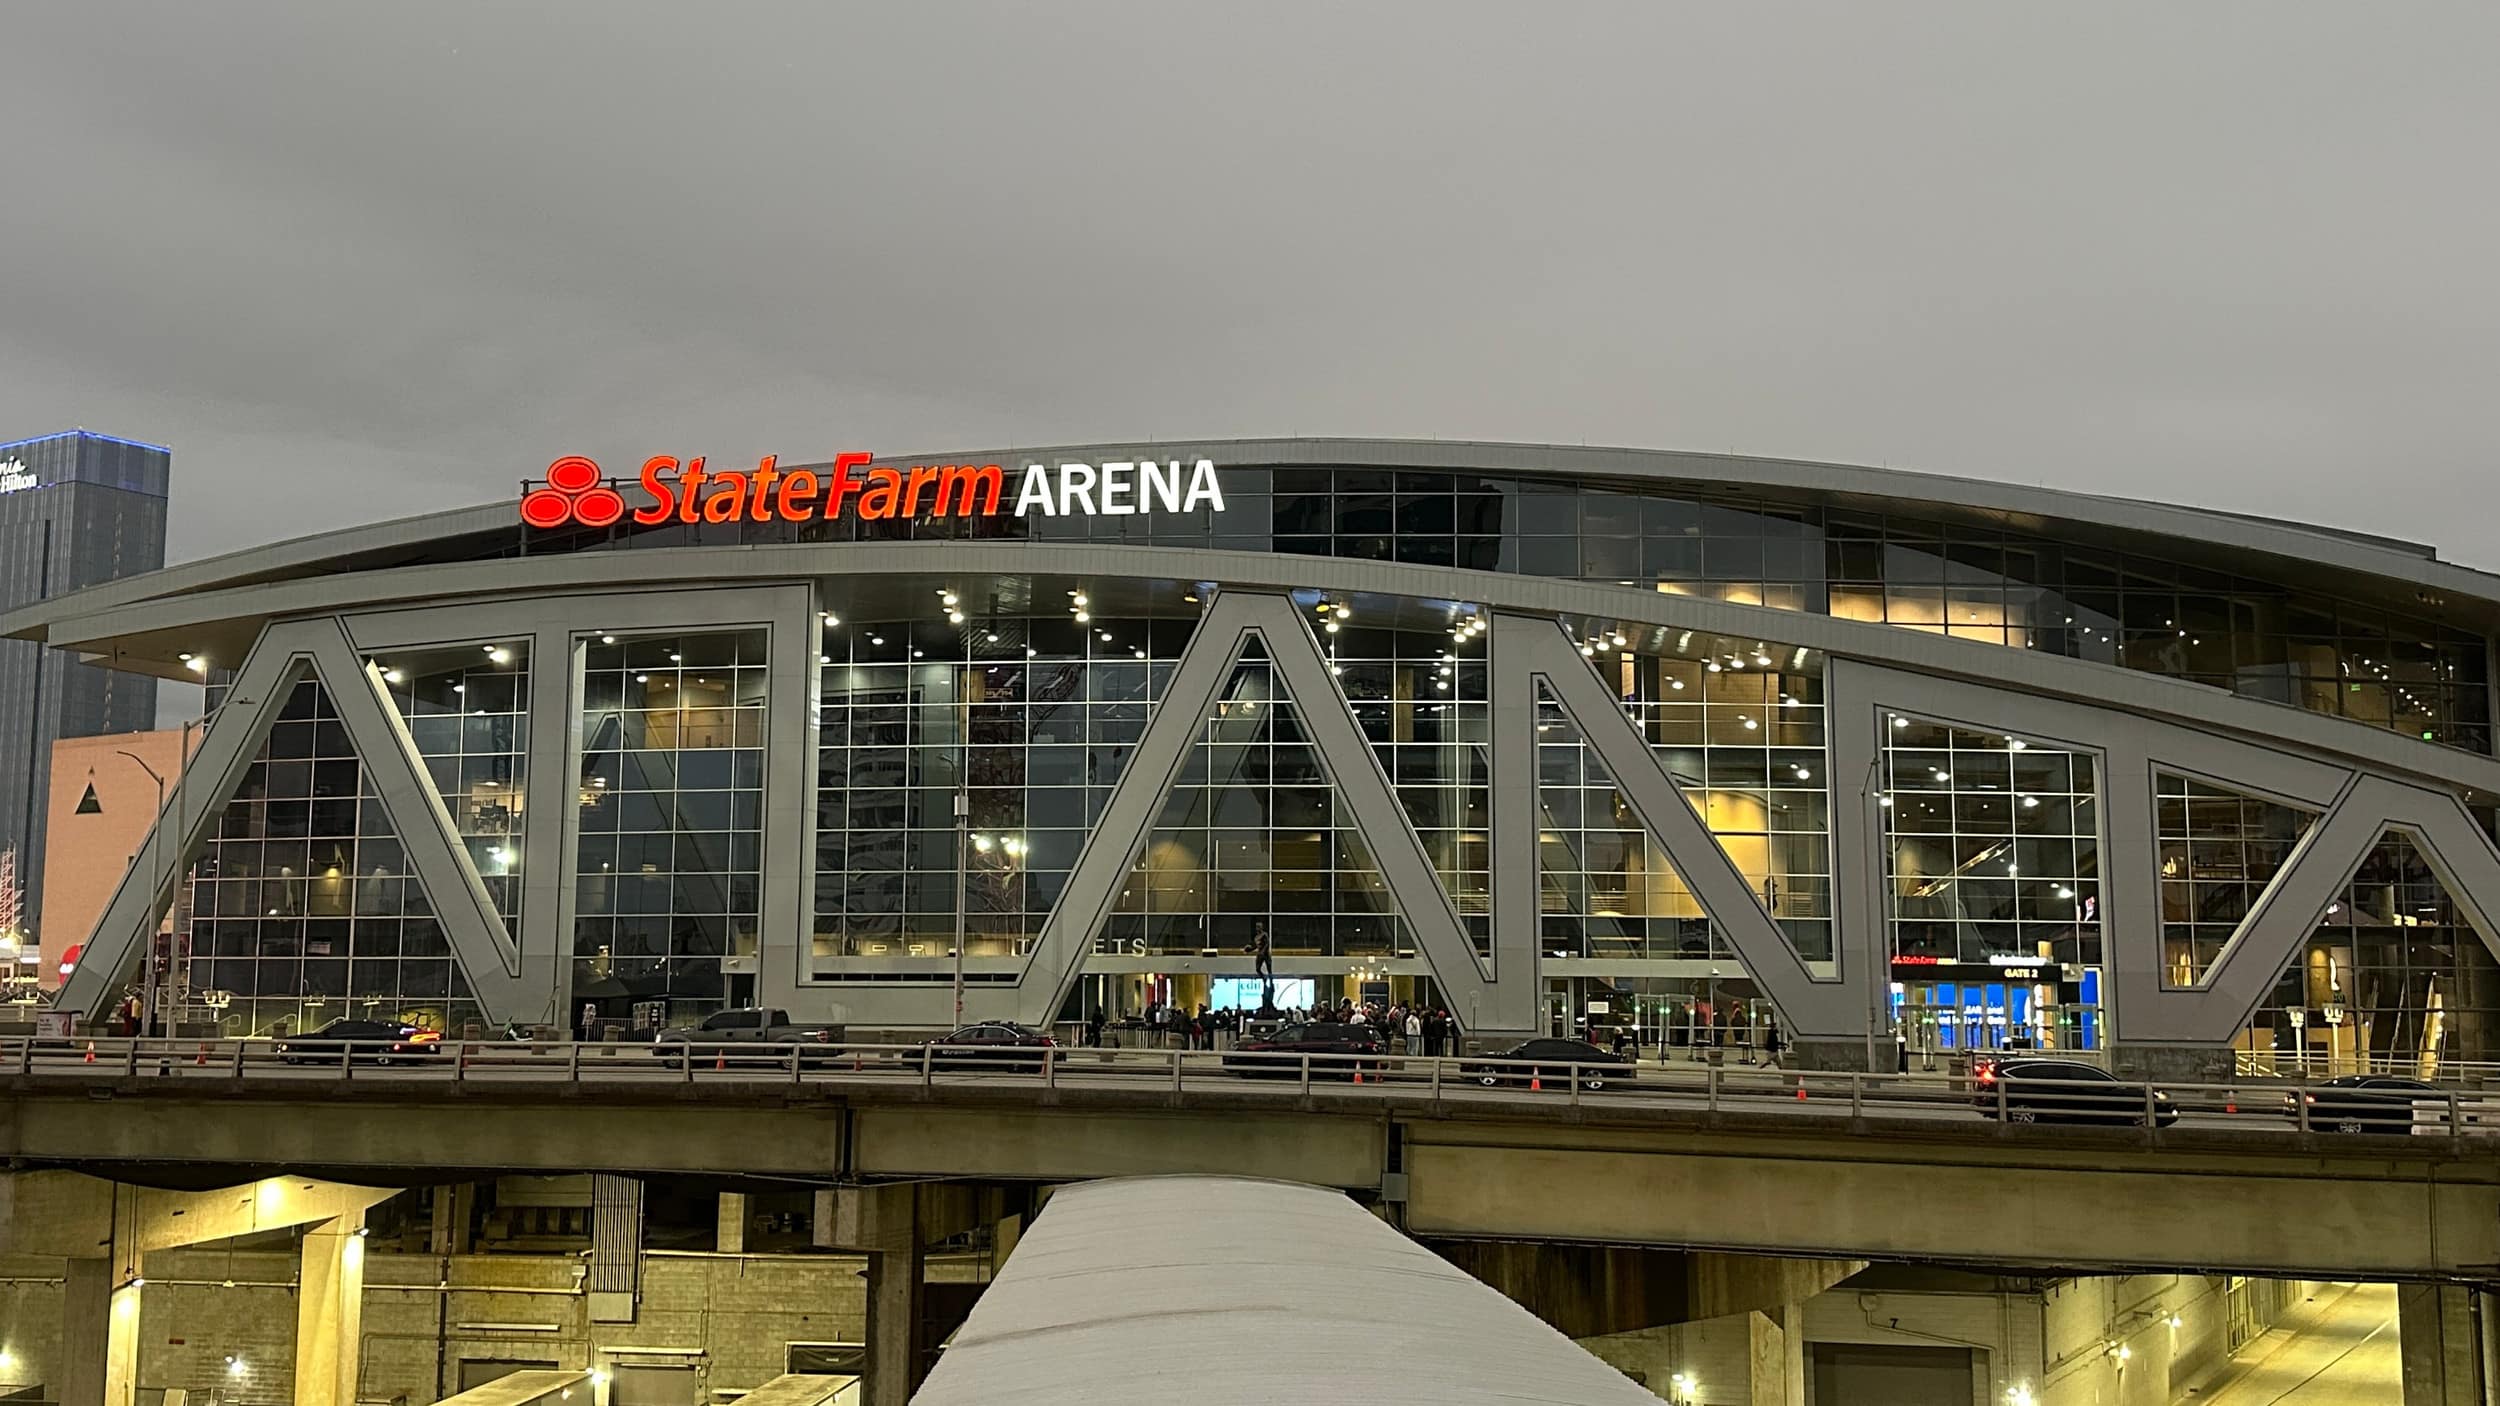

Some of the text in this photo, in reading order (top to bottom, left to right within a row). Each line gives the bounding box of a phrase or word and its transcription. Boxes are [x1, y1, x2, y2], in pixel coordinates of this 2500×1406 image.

[0, 473, 37, 493] Hilton
[1014, 459, 1226, 517] ARENA
[2004, 968, 2039, 978] GATE 2
[1889, 1317, 1899, 1329] 7
